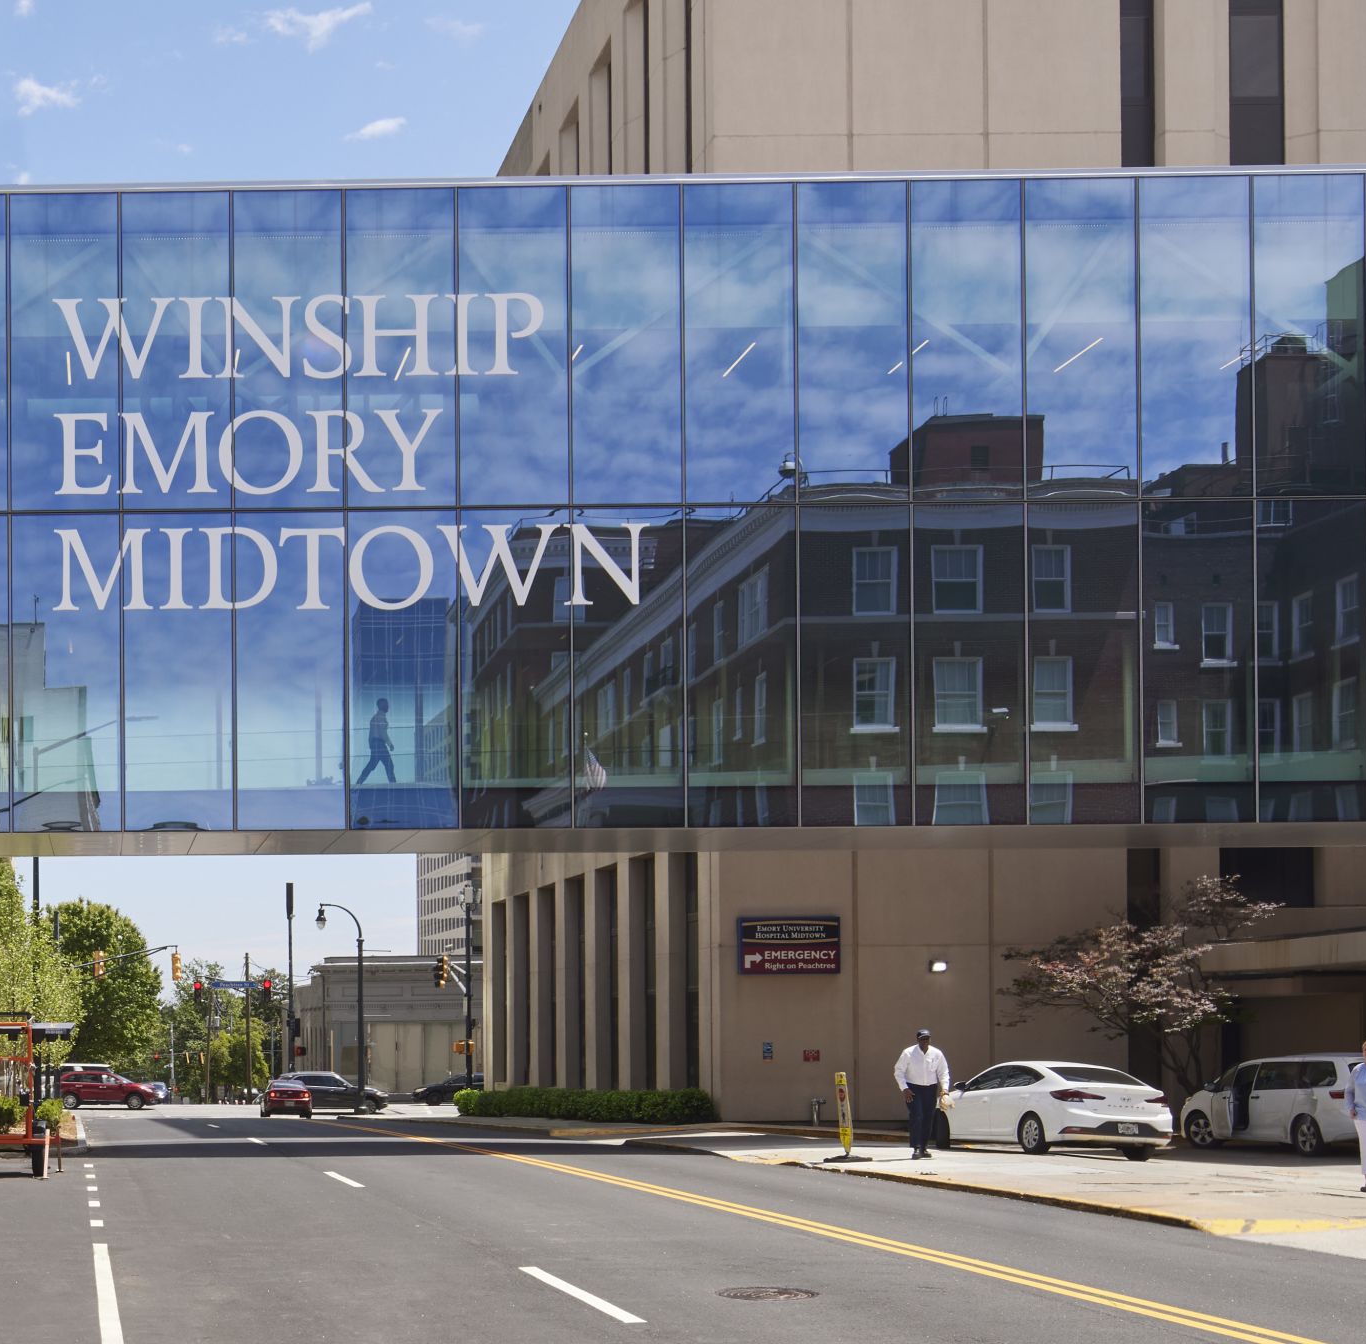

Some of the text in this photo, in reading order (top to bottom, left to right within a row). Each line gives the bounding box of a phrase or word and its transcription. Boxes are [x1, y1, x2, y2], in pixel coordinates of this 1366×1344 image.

[52, 293, 544, 379] WINSHIP
[54, 408, 443, 495] EMORY
[52, 523, 649, 611] MIDTOWN
[764, 950, 836, 960] EMERGENCY
[764, 962, 785, 971] Right
